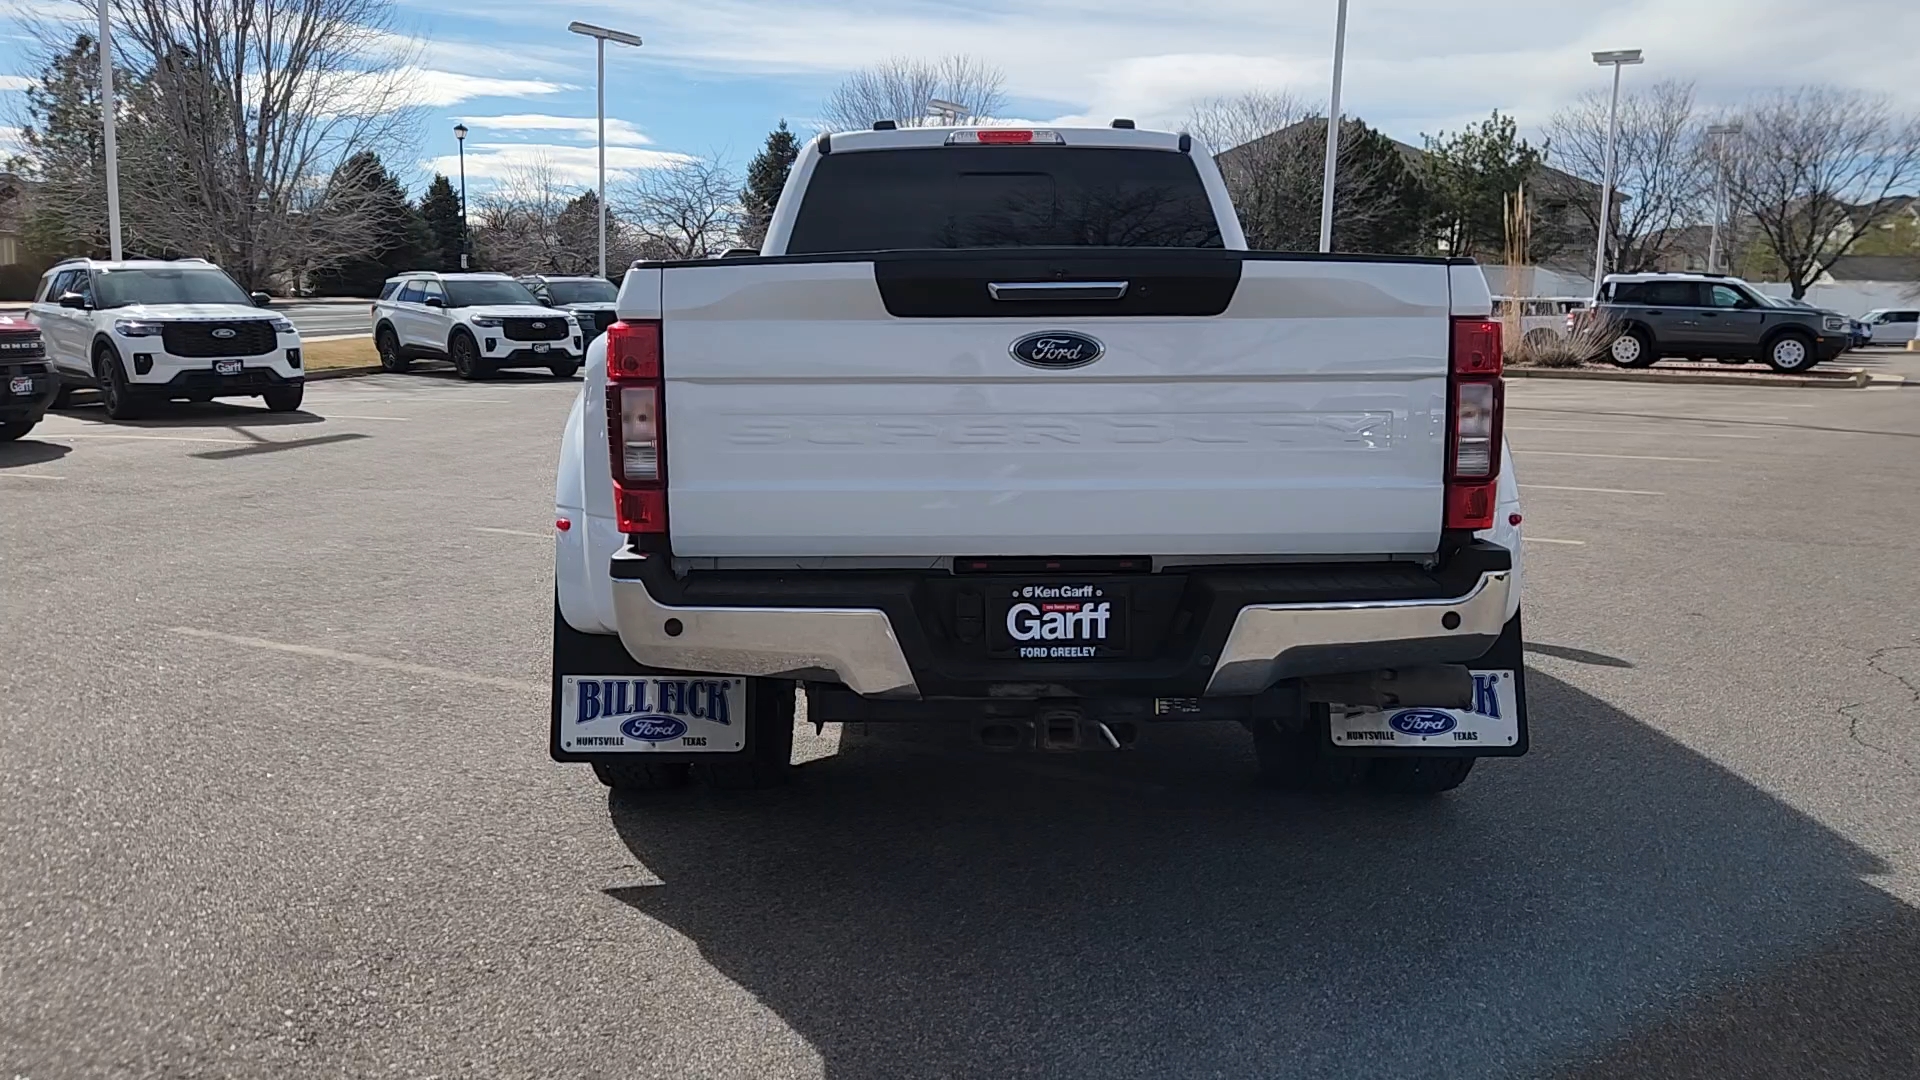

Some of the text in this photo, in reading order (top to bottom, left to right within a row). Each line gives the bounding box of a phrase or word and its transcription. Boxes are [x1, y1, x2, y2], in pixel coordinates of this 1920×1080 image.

[1031, 338, 1083, 360] Ford
[215, 362, 242, 373] Garff
[10, 379, 33, 393] Garff
[1034, 585, 1094, 598] Ken Garff
[1006, 602, 1111, 641] Garff
[1020, 646, 1096, 658] FORD GREELEY
[575, 679, 732, 726] BILL FICK
[631, 719, 676, 737] Ford
[1400, 714, 1446, 731] Ford
[576, 736, 707, 747] HUNTSVILLE TEXAS
[1346, 731, 1478, 741] HUNTSVILLE TEXAS
